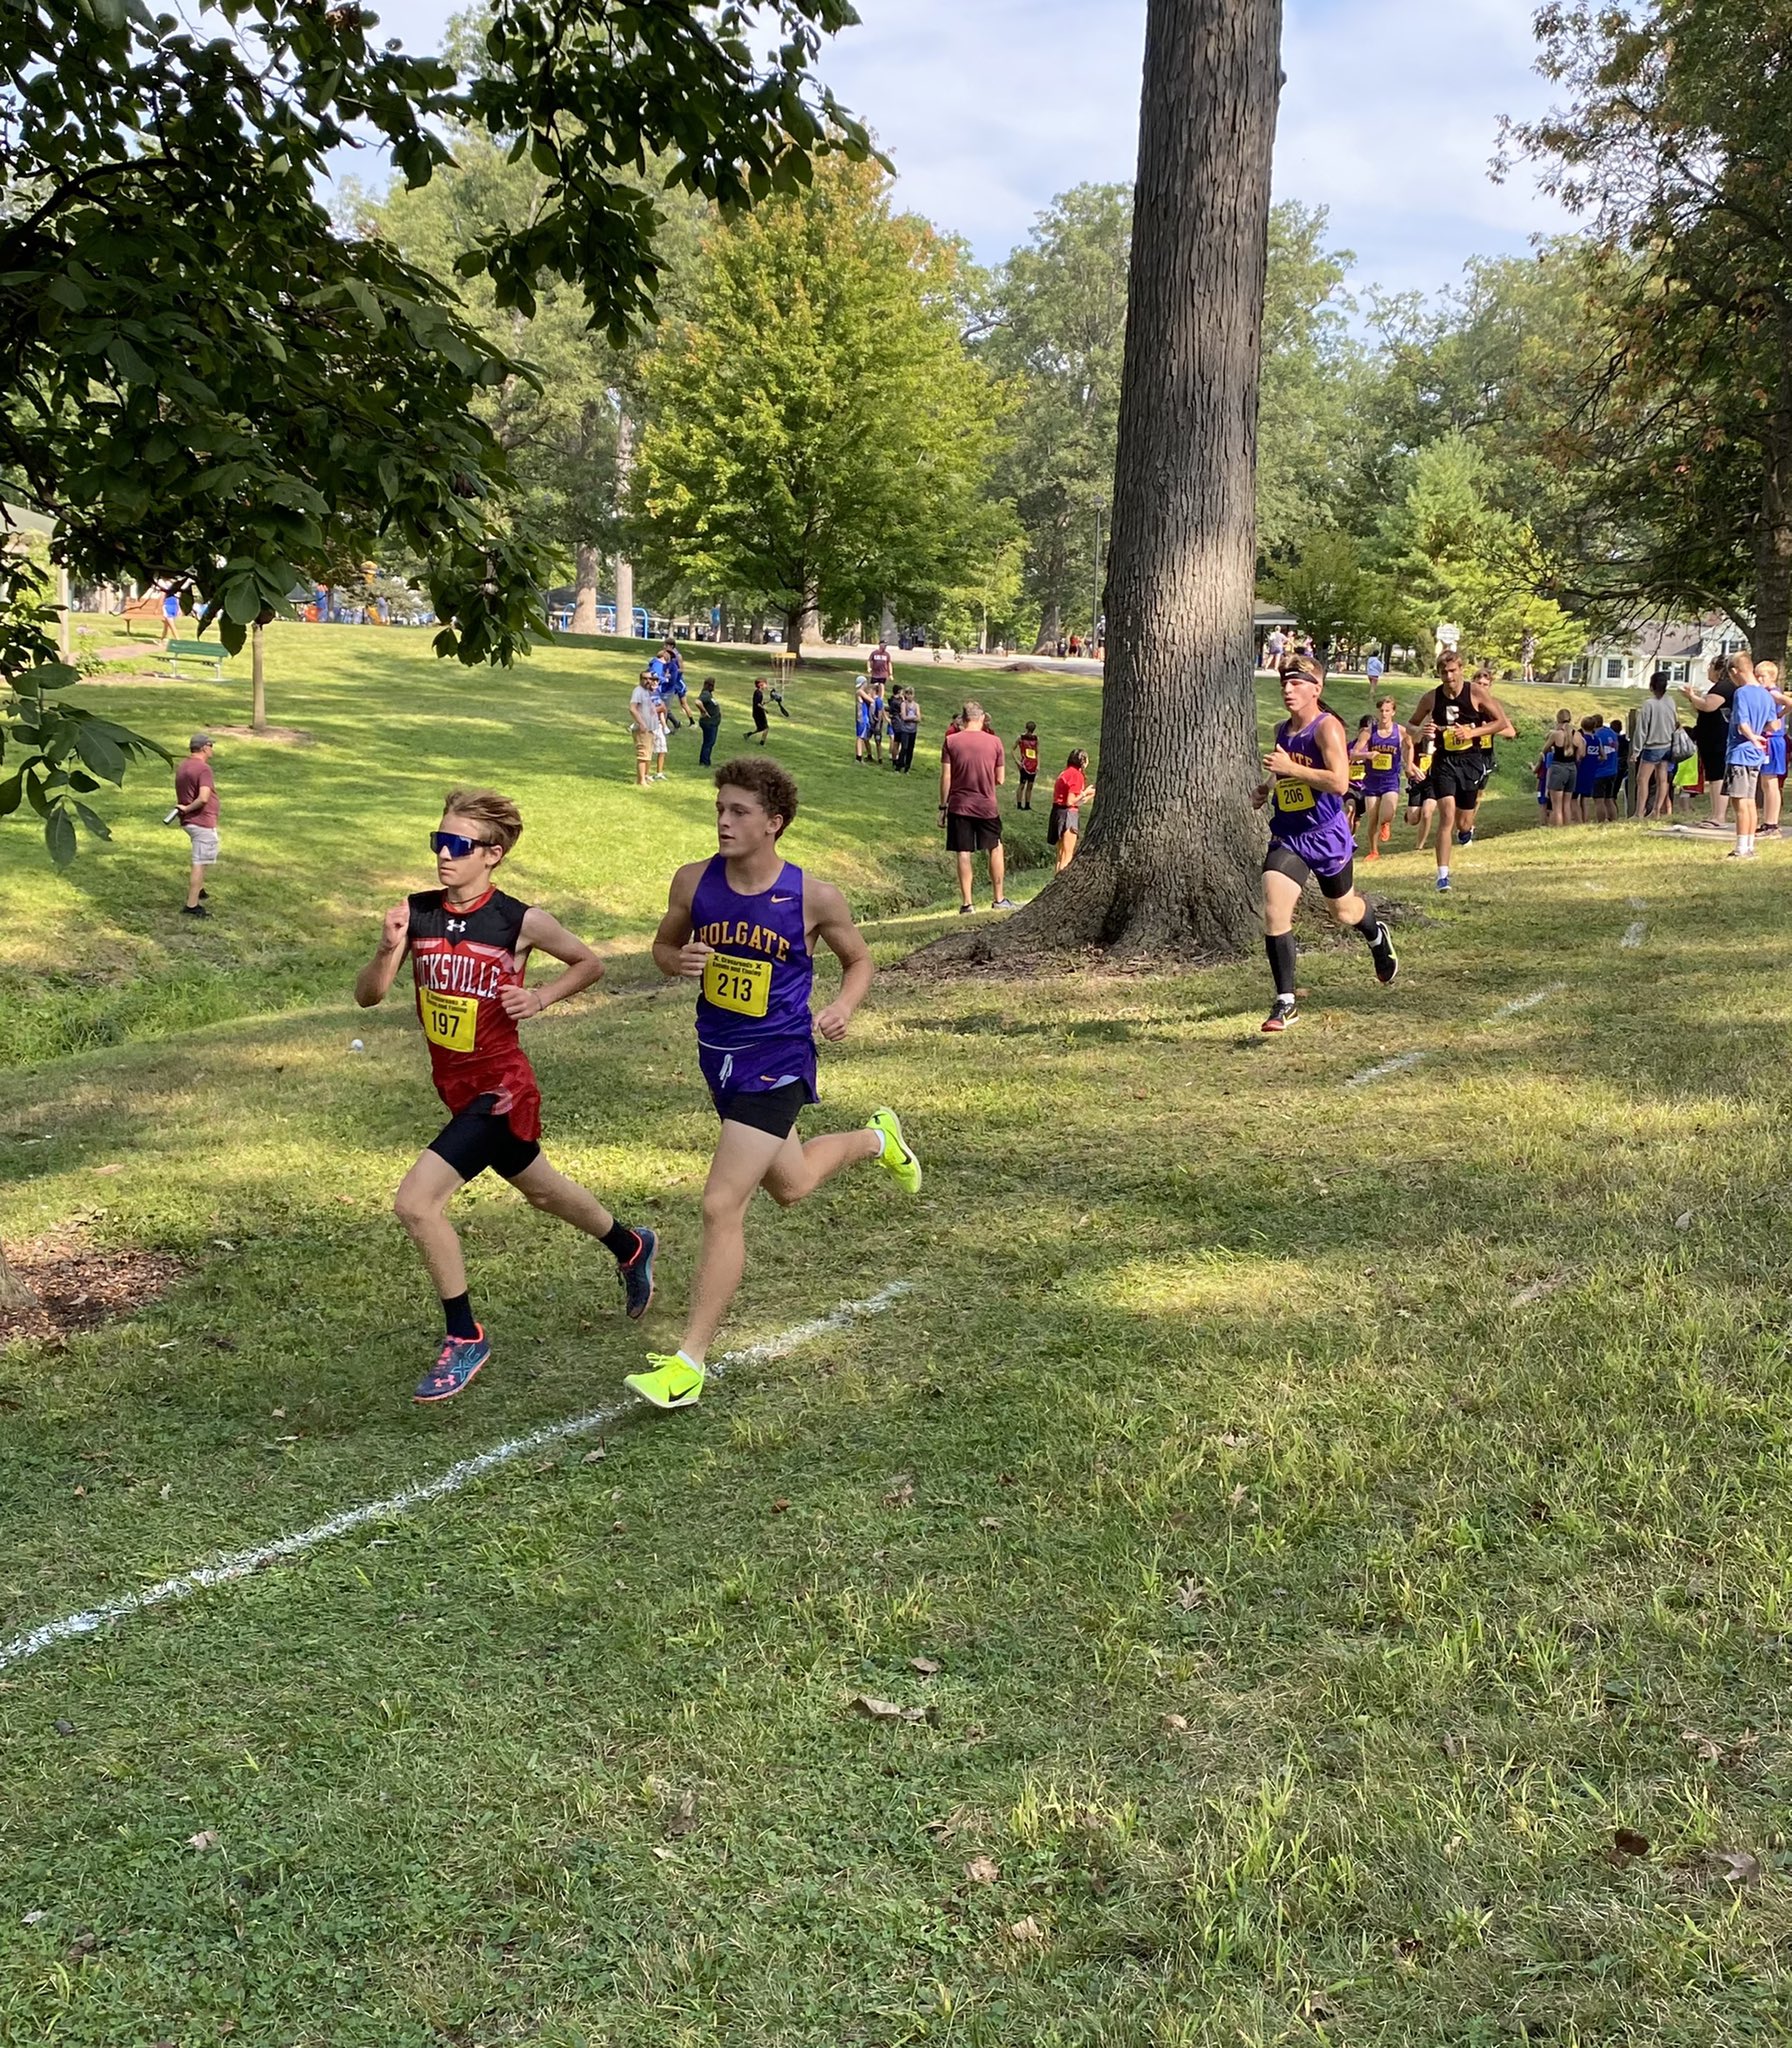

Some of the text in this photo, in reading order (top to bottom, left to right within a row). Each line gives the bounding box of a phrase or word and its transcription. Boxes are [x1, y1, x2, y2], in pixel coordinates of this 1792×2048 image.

[1283, 787, 1304, 805] 206
[699, 921, 791, 962] HOLGATE
[416, 953, 501, 1000] ICKSVILLE
[717, 972, 753, 1002] 213
[431, 1009, 460, 1038] 197
